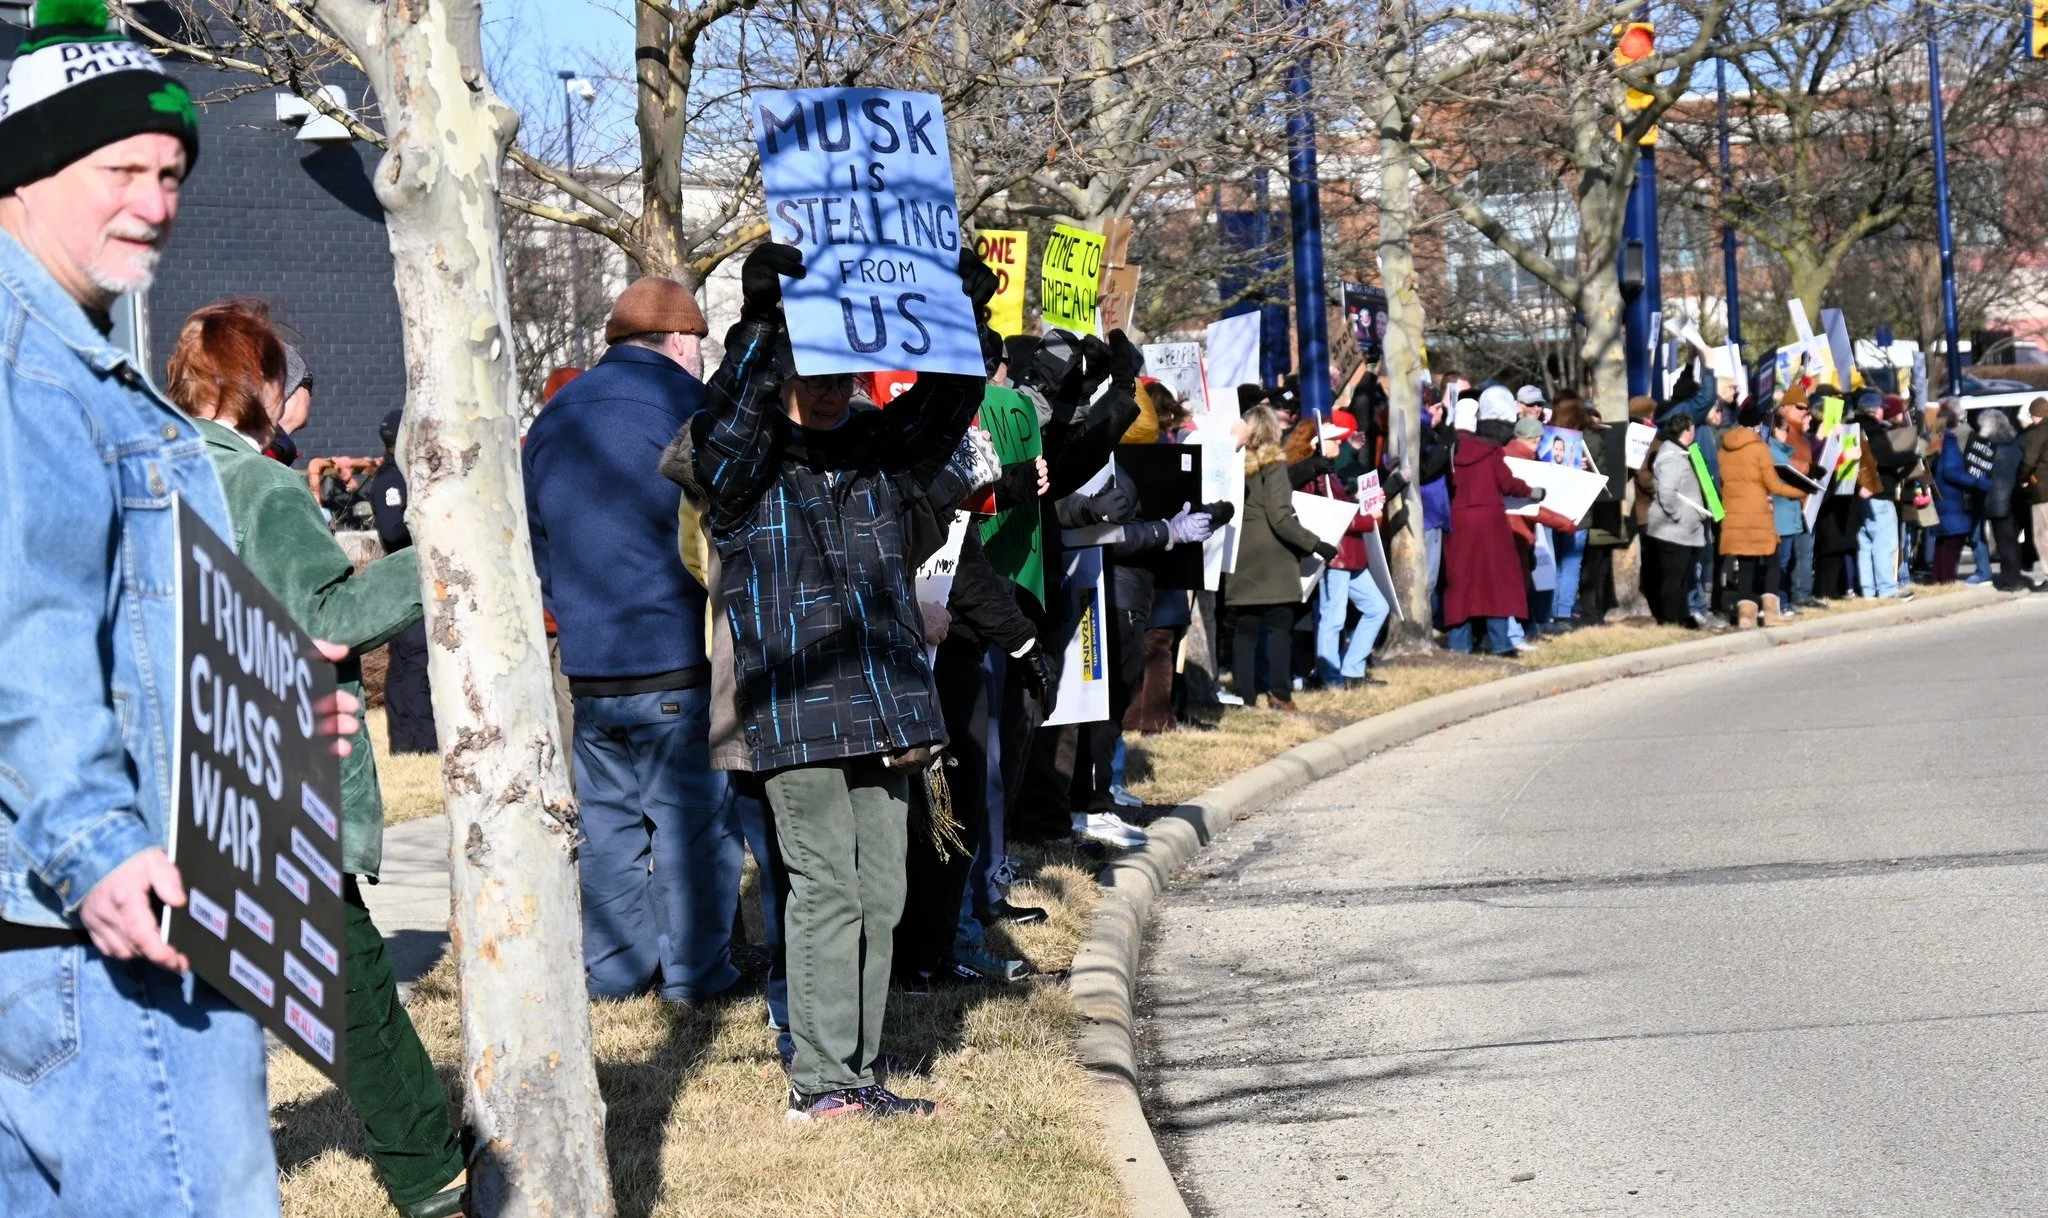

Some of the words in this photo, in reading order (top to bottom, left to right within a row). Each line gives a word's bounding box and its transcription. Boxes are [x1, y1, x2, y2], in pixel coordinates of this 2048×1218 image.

[759, 97, 936, 156] MUSK
[849, 162, 885, 192] IS
[775, 197, 957, 252] STEALING
[973, 234, 1016, 264] ONE
[838, 258, 917, 284] FROM
[1046, 231, 1080, 273] TIME
[1082, 241, 1100, 278] TO
[839, 291, 931, 356] US
[1042, 276, 1097, 325] IMPEACH
[192, 544, 315, 739] TRUMP'S
[191, 751, 262, 887] WAR
[313, 1030, 332, 1056] LOSE
